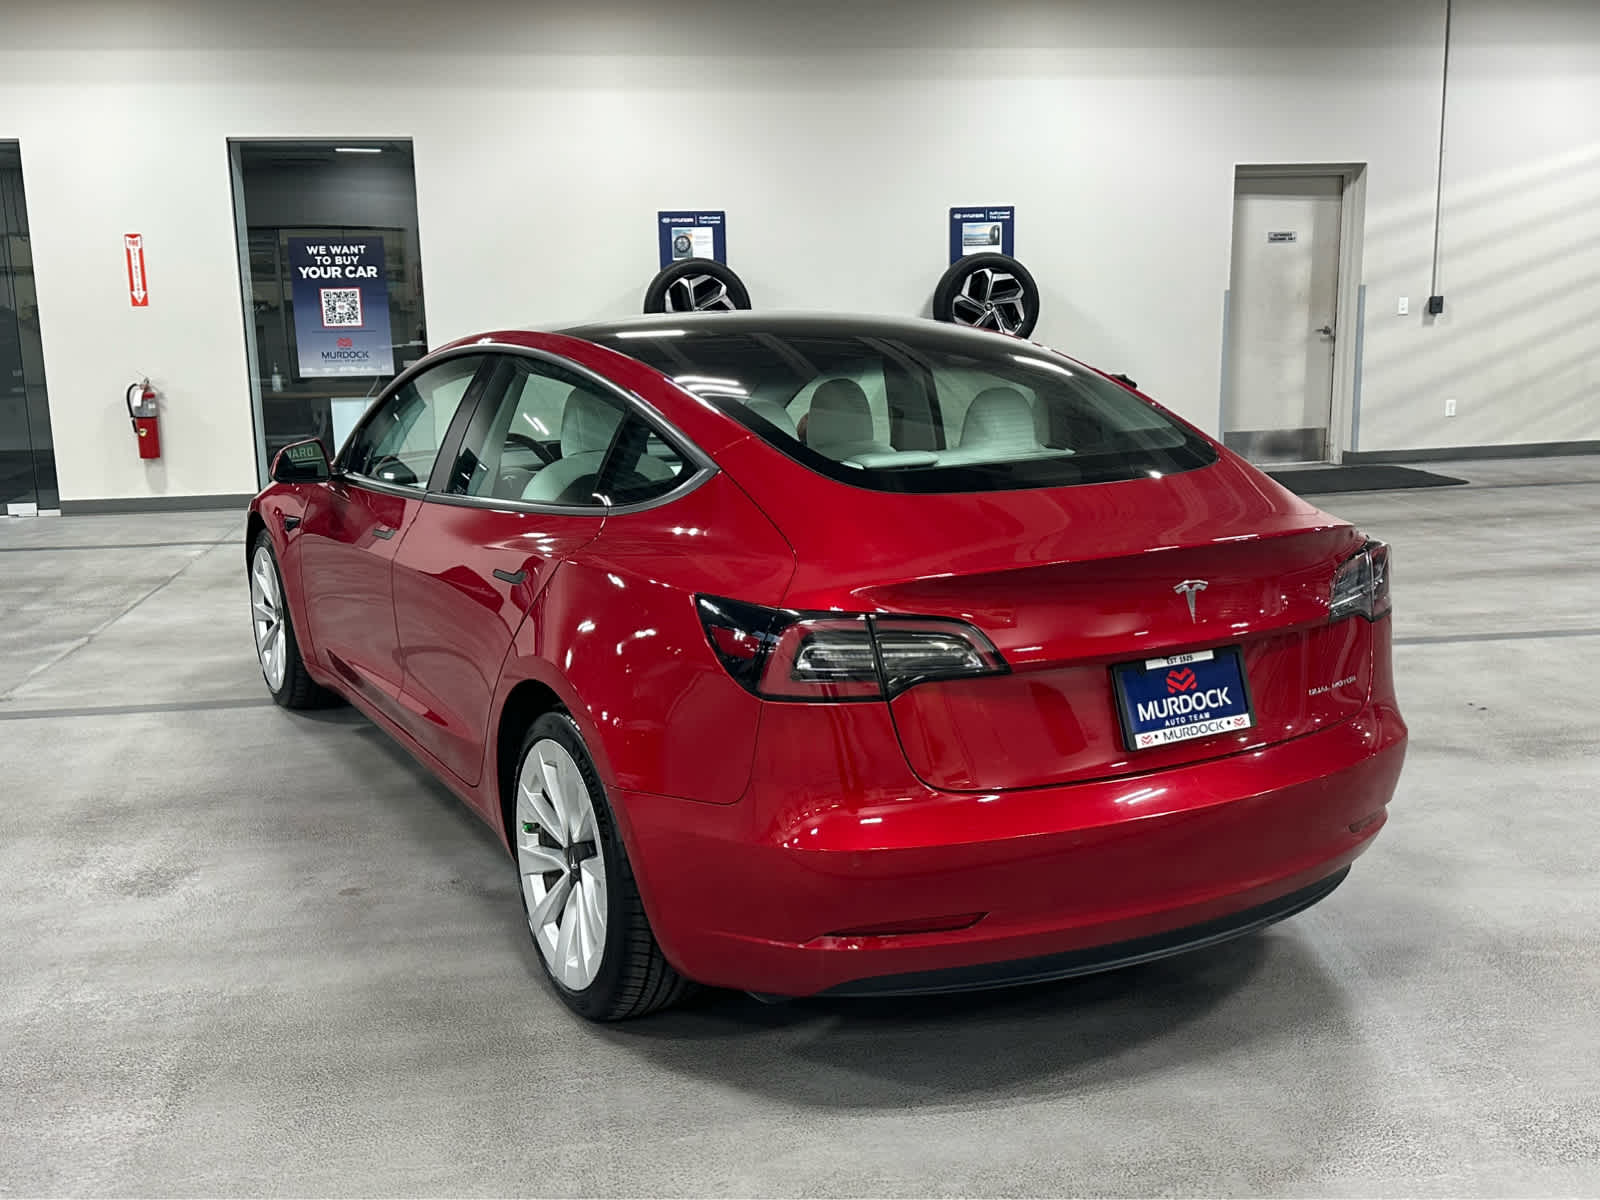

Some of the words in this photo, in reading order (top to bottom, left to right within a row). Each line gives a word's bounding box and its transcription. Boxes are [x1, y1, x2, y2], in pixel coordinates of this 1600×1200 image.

[306, 246, 327, 254] WE
[329, 245, 366, 254] WANT
[314, 256, 332, 265] TO
[335, 256, 359, 265] BUY
[298, 266, 342, 279] YOUR
[344, 265, 378, 278] CAR
[321, 351, 369, 360] MURDOCK
[1137, 687, 1232, 722] MURDOCK
[1165, 717, 1186, 727] AUTO
[1188, 712, 1210, 722] TEAM
[1163, 721, 1225, 741] MURDOCK
